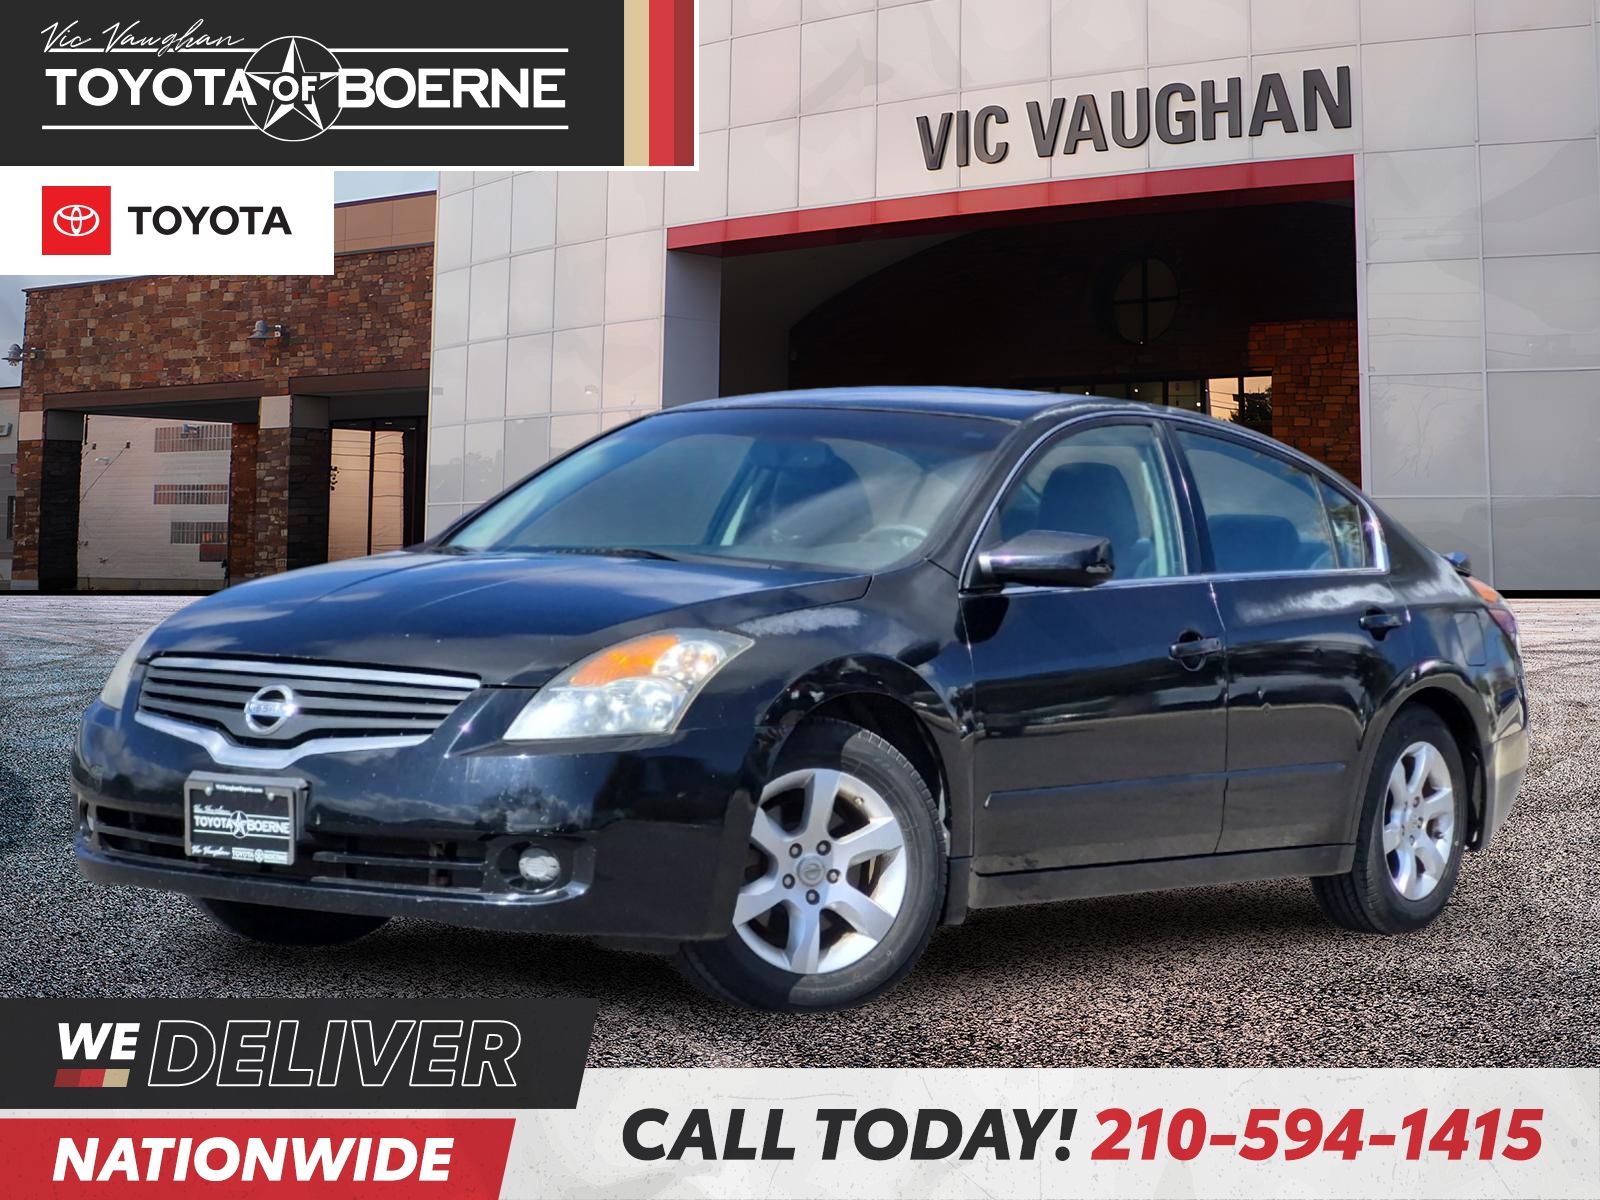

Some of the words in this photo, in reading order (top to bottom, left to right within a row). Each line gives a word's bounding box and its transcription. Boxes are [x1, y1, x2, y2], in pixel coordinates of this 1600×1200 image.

[916, 105, 1009, 171] VIC
[1026, 66, 1352, 158] VAUGHAN
[193, 815, 233, 829] TOYOTA
[247, 819, 291, 834] BOERNE
